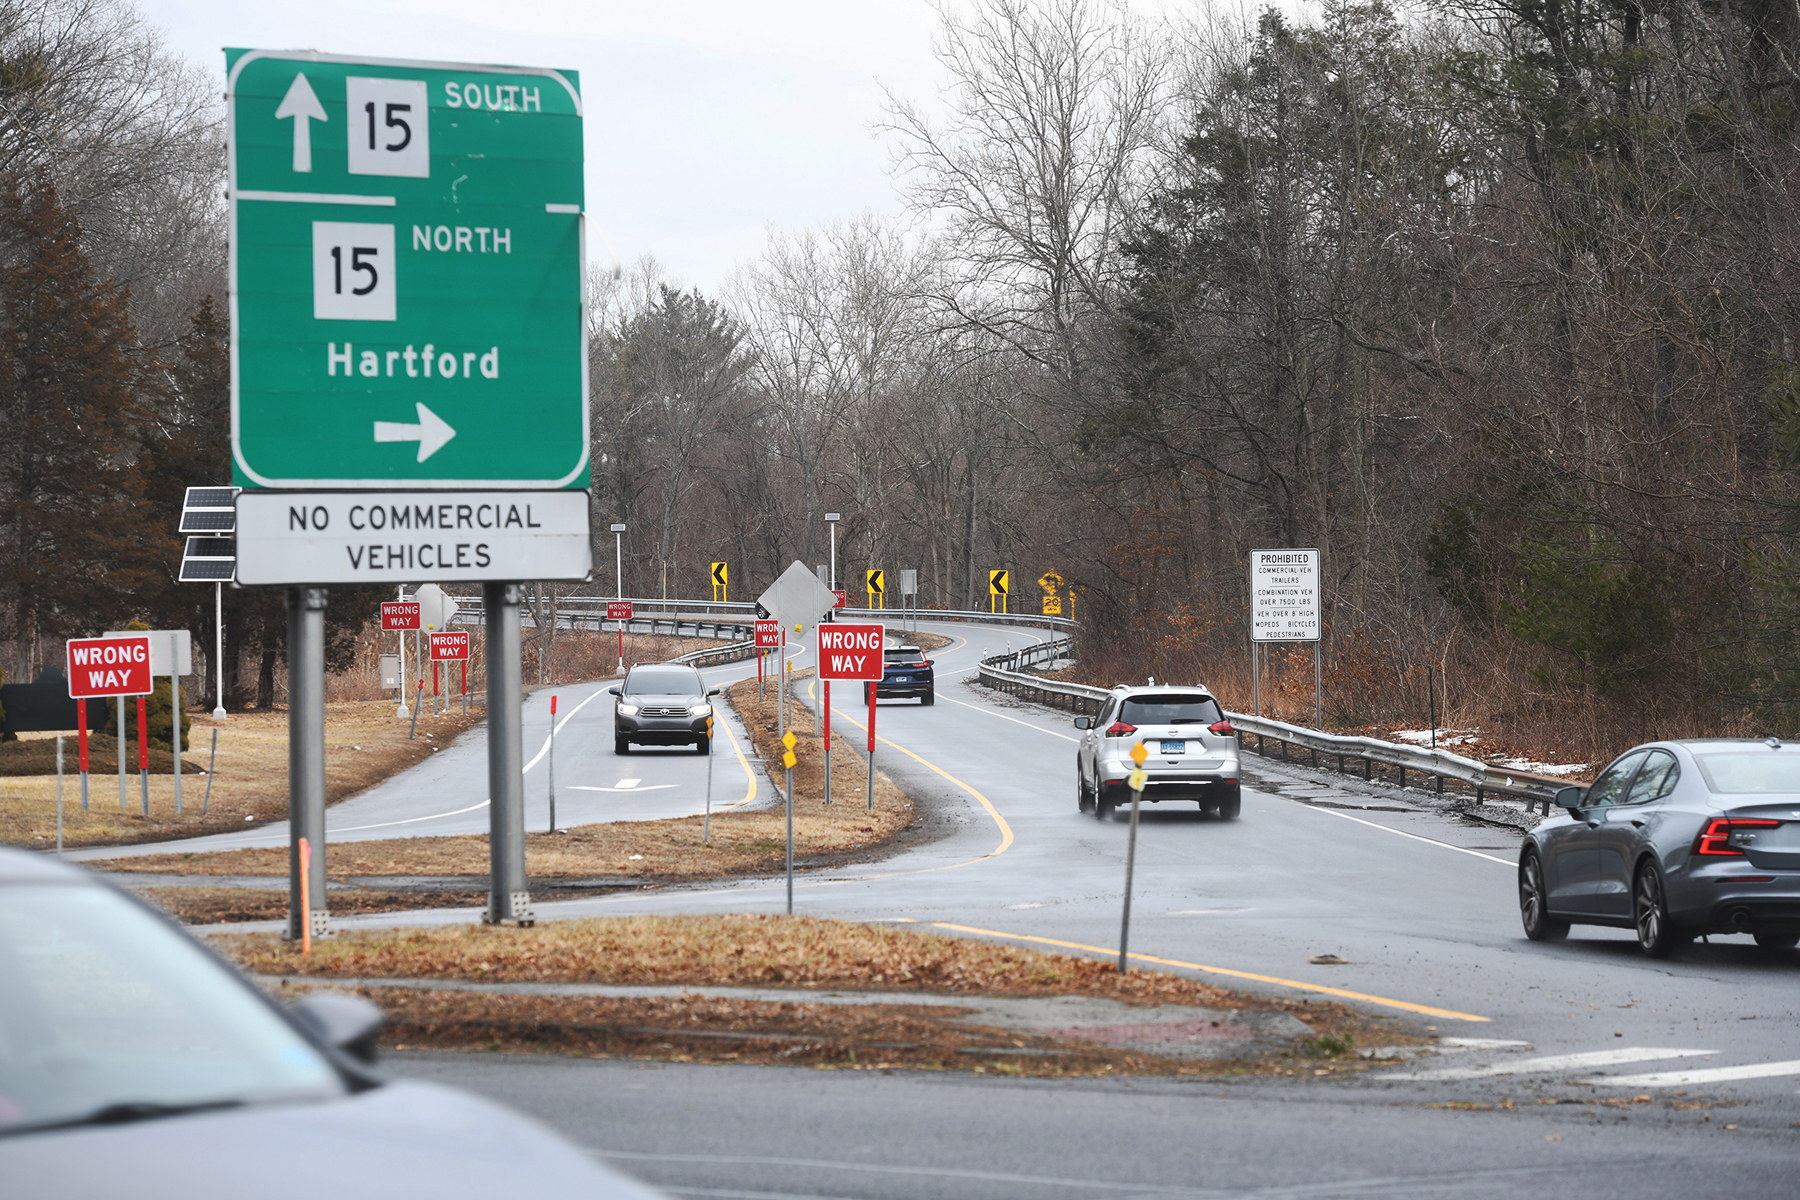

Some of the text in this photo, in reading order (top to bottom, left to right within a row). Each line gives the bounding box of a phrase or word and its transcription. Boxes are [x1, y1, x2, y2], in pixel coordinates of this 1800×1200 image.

[445, 81, 541, 112] SOUTH
[365, 102, 412, 152] 15
[412, 225, 511, 254] NORTH
[331, 246, 378, 295] 15
[327, 342, 499, 379] Hartford
[289, 504, 541, 531] NO COMMERCIAL
[346, 543, 491, 570] VEHICLES
[1261, 554, 1309, 563] PROHIBITED
[383, 605, 419, 615] WRONG
[1045, 598, 1059, 607] 20
[390, 617, 411, 626] WAY
[756, 623, 784, 633] WRON
[432, 636, 467, 645] WRONG
[762, 635, 779, 643] WAY
[821, 631, 880, 650] WRONG
[73, 644, 146, 666] WRONG
[439, 647, 460, 656] WAY
[831, 655, 866, 673] WAY
[88, 669, 132, 689] WAY
